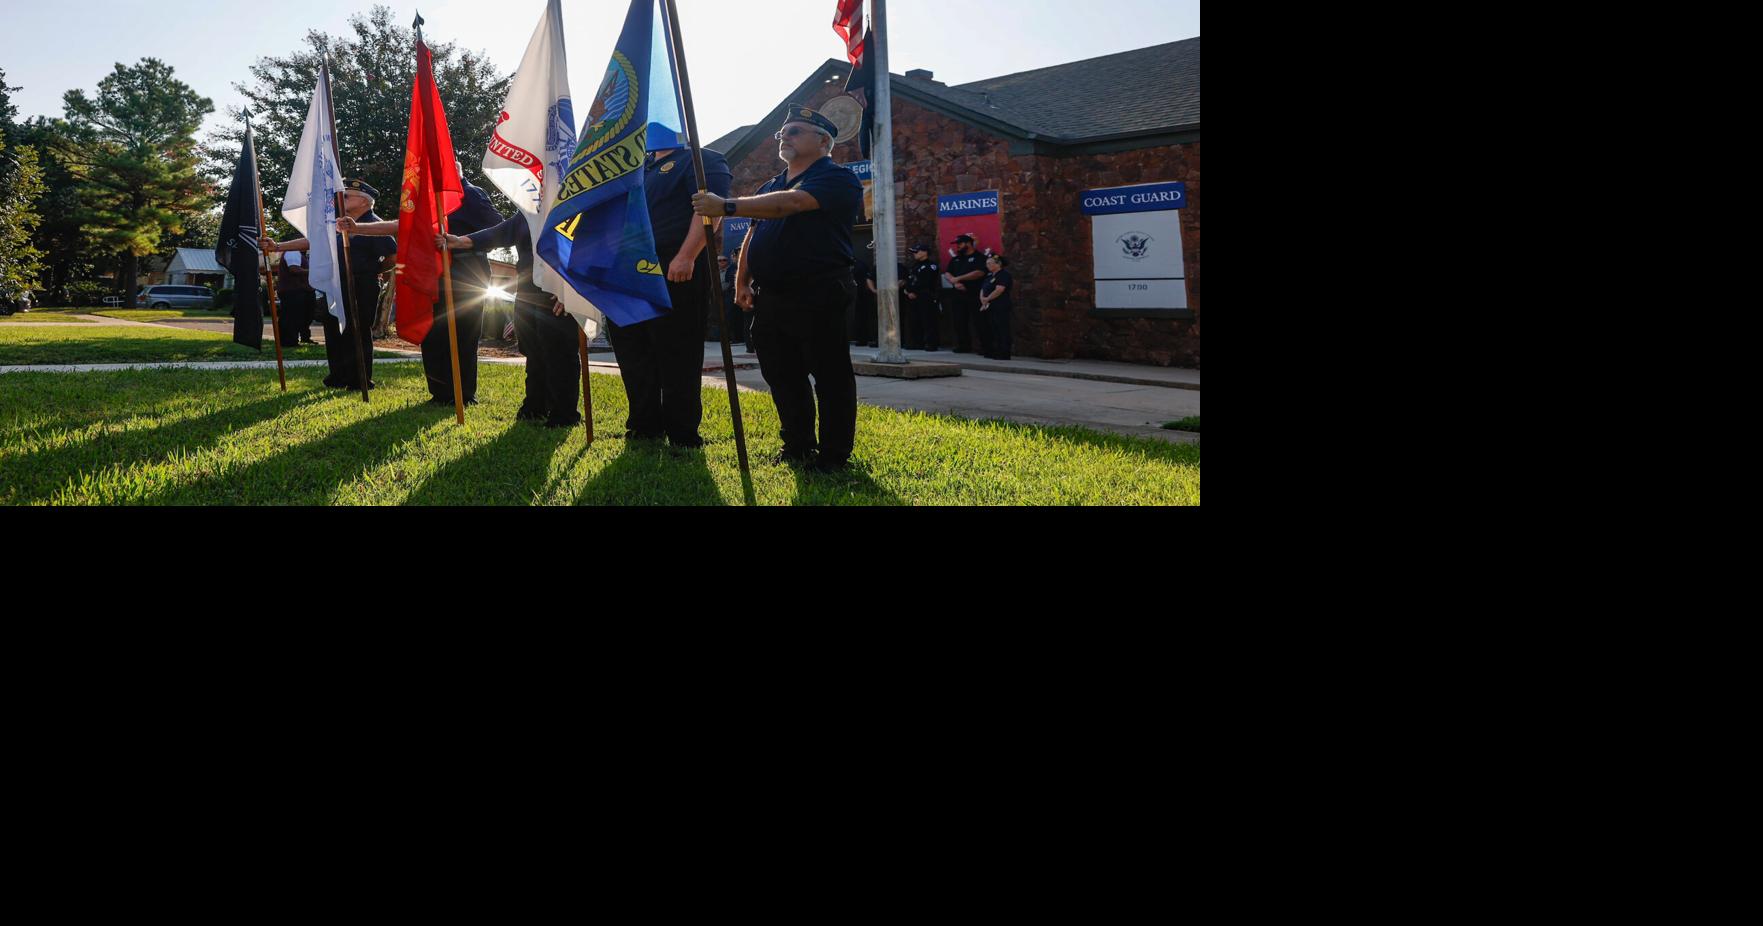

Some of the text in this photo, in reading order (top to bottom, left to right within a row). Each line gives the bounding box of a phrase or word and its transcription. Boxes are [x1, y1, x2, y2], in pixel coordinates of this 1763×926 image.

[490, 137, 534, 165] NITED
[940, 197, 997, 211] MARINES
[1084, 190, 1181, 207] COAST GUARD
[730, 221, 751, 231] NAVY
